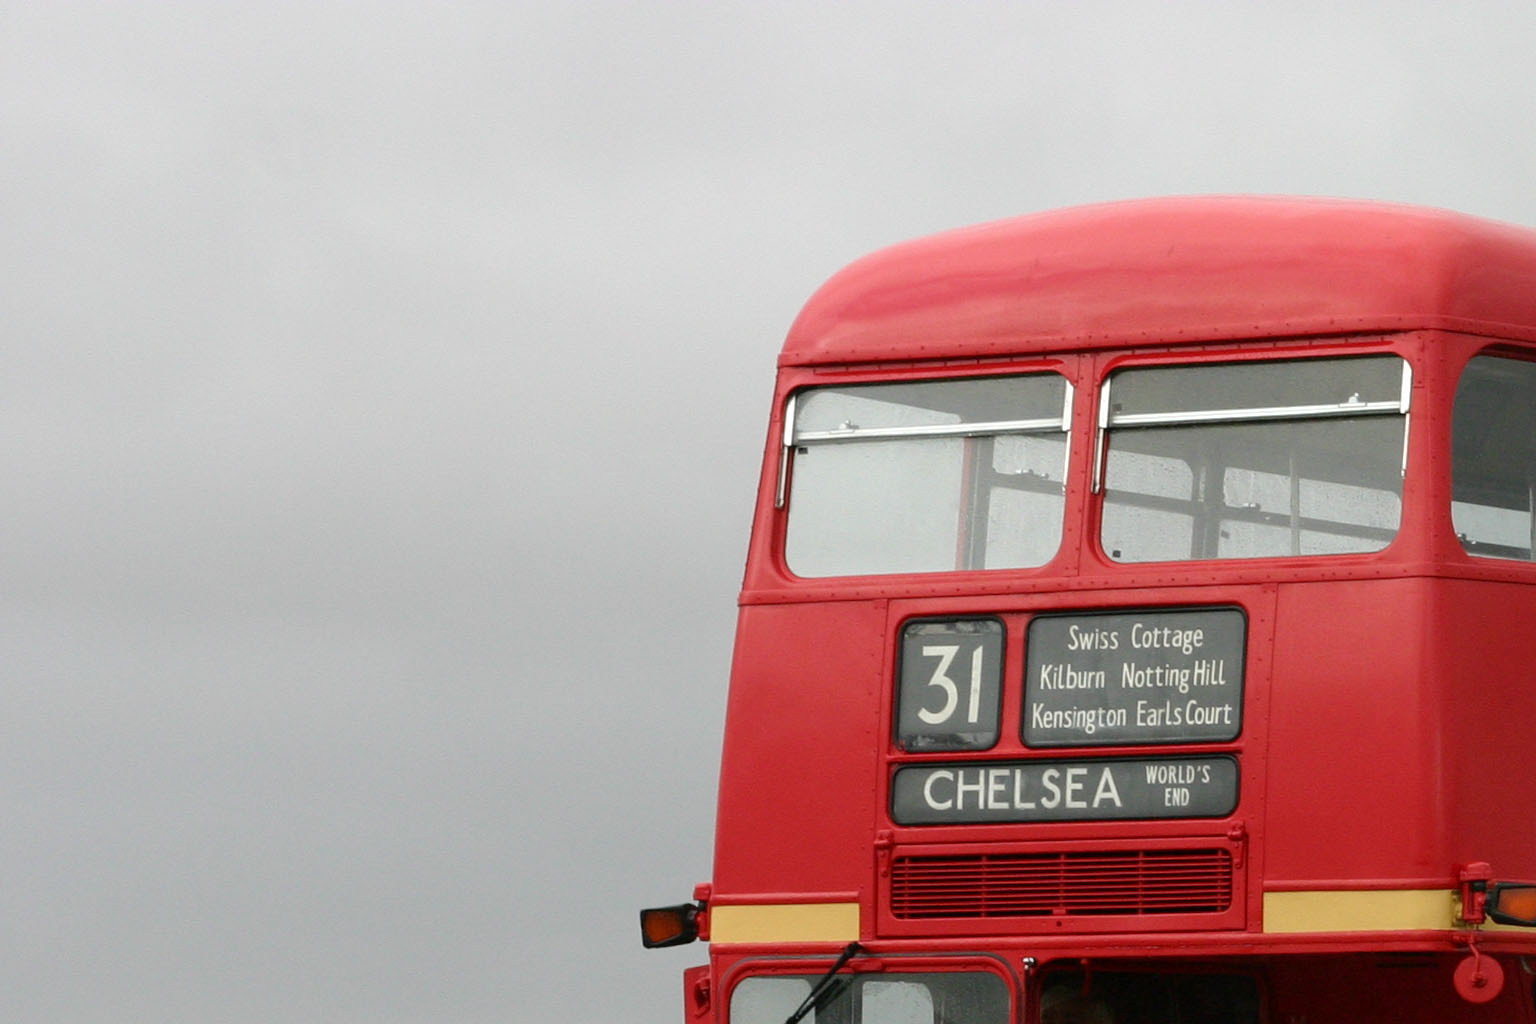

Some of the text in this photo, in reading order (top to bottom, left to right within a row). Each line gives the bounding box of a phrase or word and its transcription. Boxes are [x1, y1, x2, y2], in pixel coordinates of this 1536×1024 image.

[1068, 623, 1203, 655] Swiss Cottage
[917, 644, 983, 725] 31
[1040, 659, 1226, 694] Kilburn Notting Hill
[1032, 700, 1232, 734] Kensington Earls Court
[923, 767, 1123, 810] CHELSEA
[1145, 765, 1211, 785] WORLD'S
[1164, 788, 1190, 807] END
